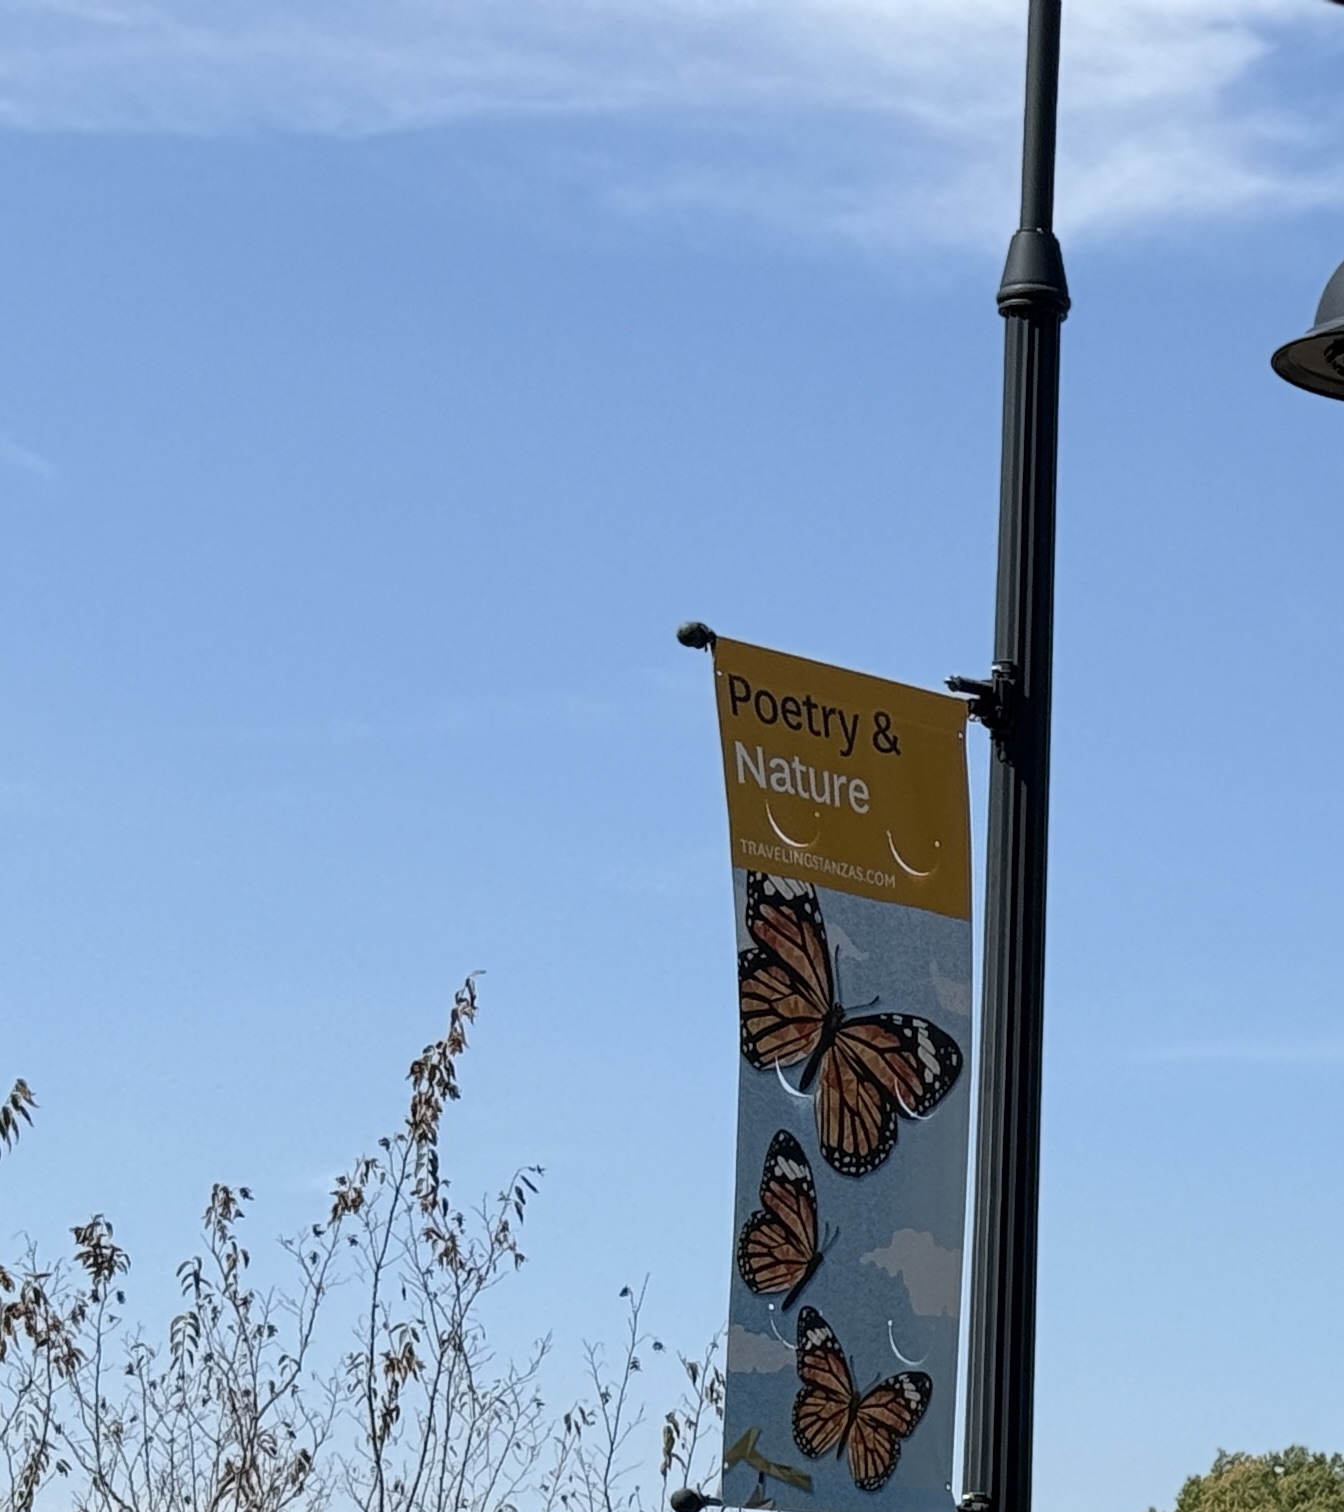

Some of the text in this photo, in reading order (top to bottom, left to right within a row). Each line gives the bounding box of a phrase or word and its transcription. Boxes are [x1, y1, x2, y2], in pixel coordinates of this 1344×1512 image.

[728, 674, 901, 757] Poetry &
[734, 741, 870, 815] Nature
[740, 838, 896, 888] TRAVELINGSTANZAS.COM
